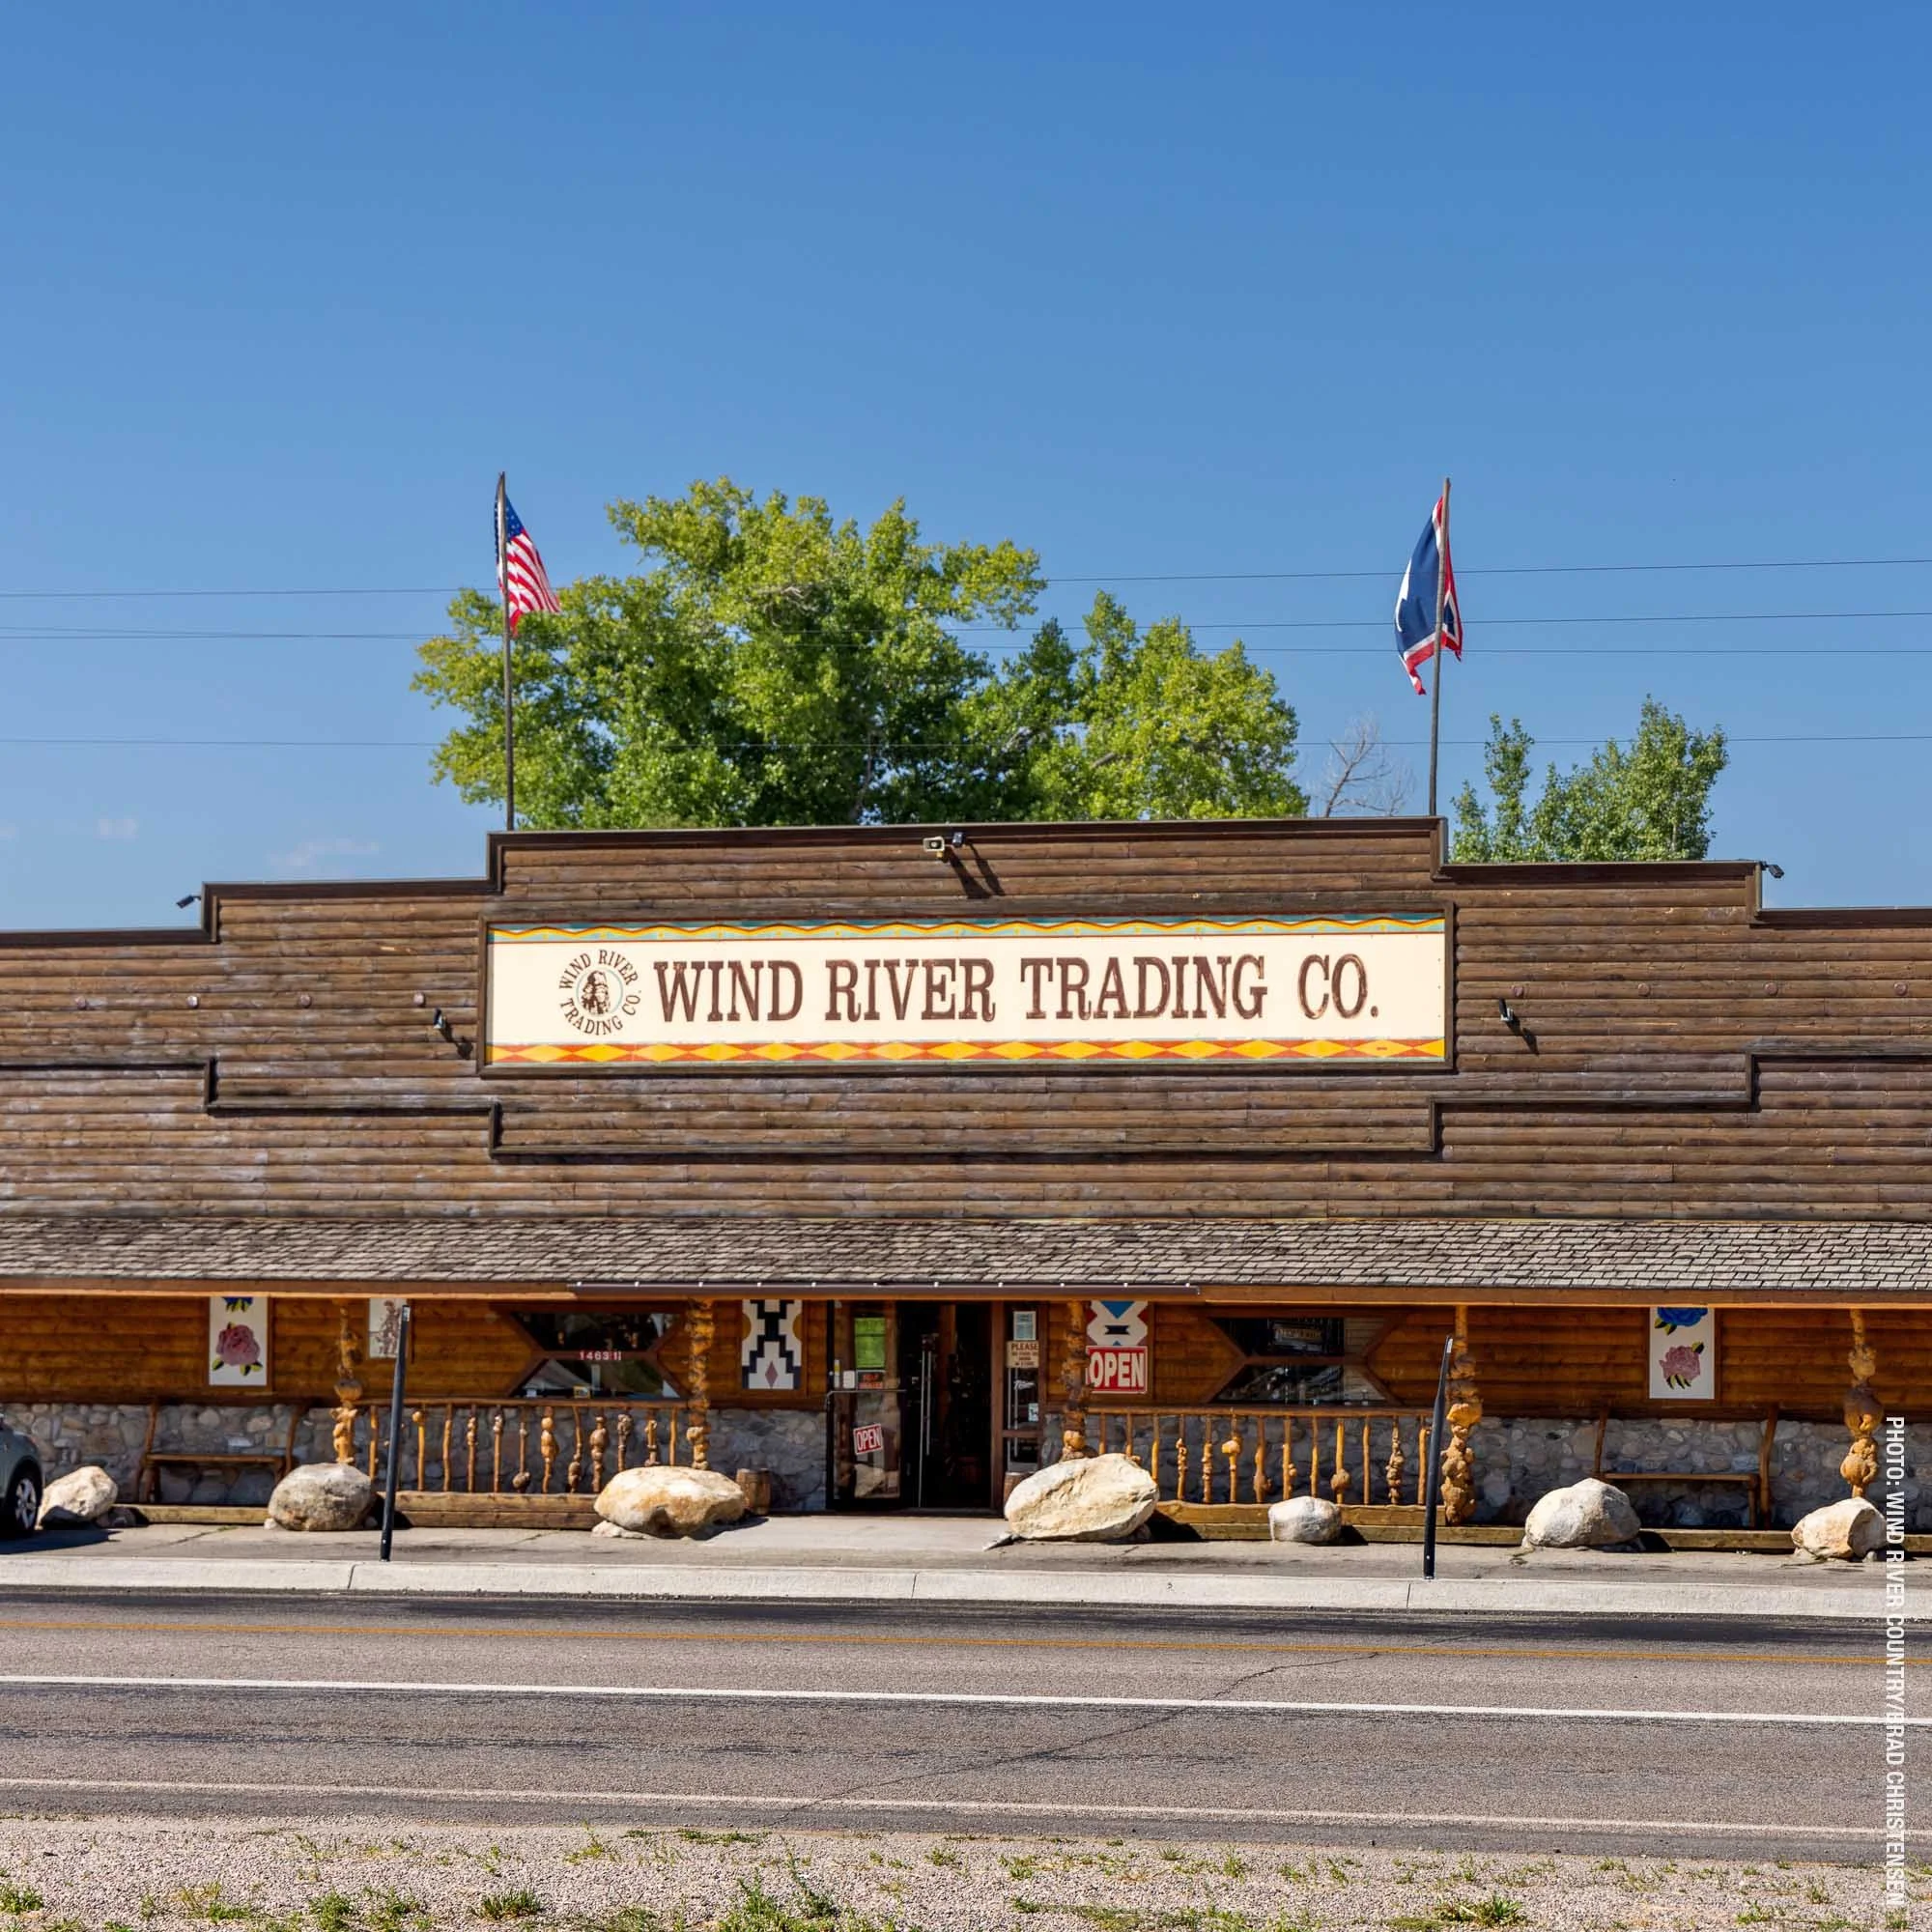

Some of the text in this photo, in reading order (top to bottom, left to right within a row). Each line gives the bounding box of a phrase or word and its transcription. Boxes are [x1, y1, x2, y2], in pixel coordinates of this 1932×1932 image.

[559, 950, 639, 989] WIND RIVER
[654, 954, 1378, 1022] WIND RIVER TRADING CO.
[560, 998, 623, 1036] TRADING
[1089, 1352, 1145, 1388] OPEN
[856, 1427, 881, 1451] OPEN
